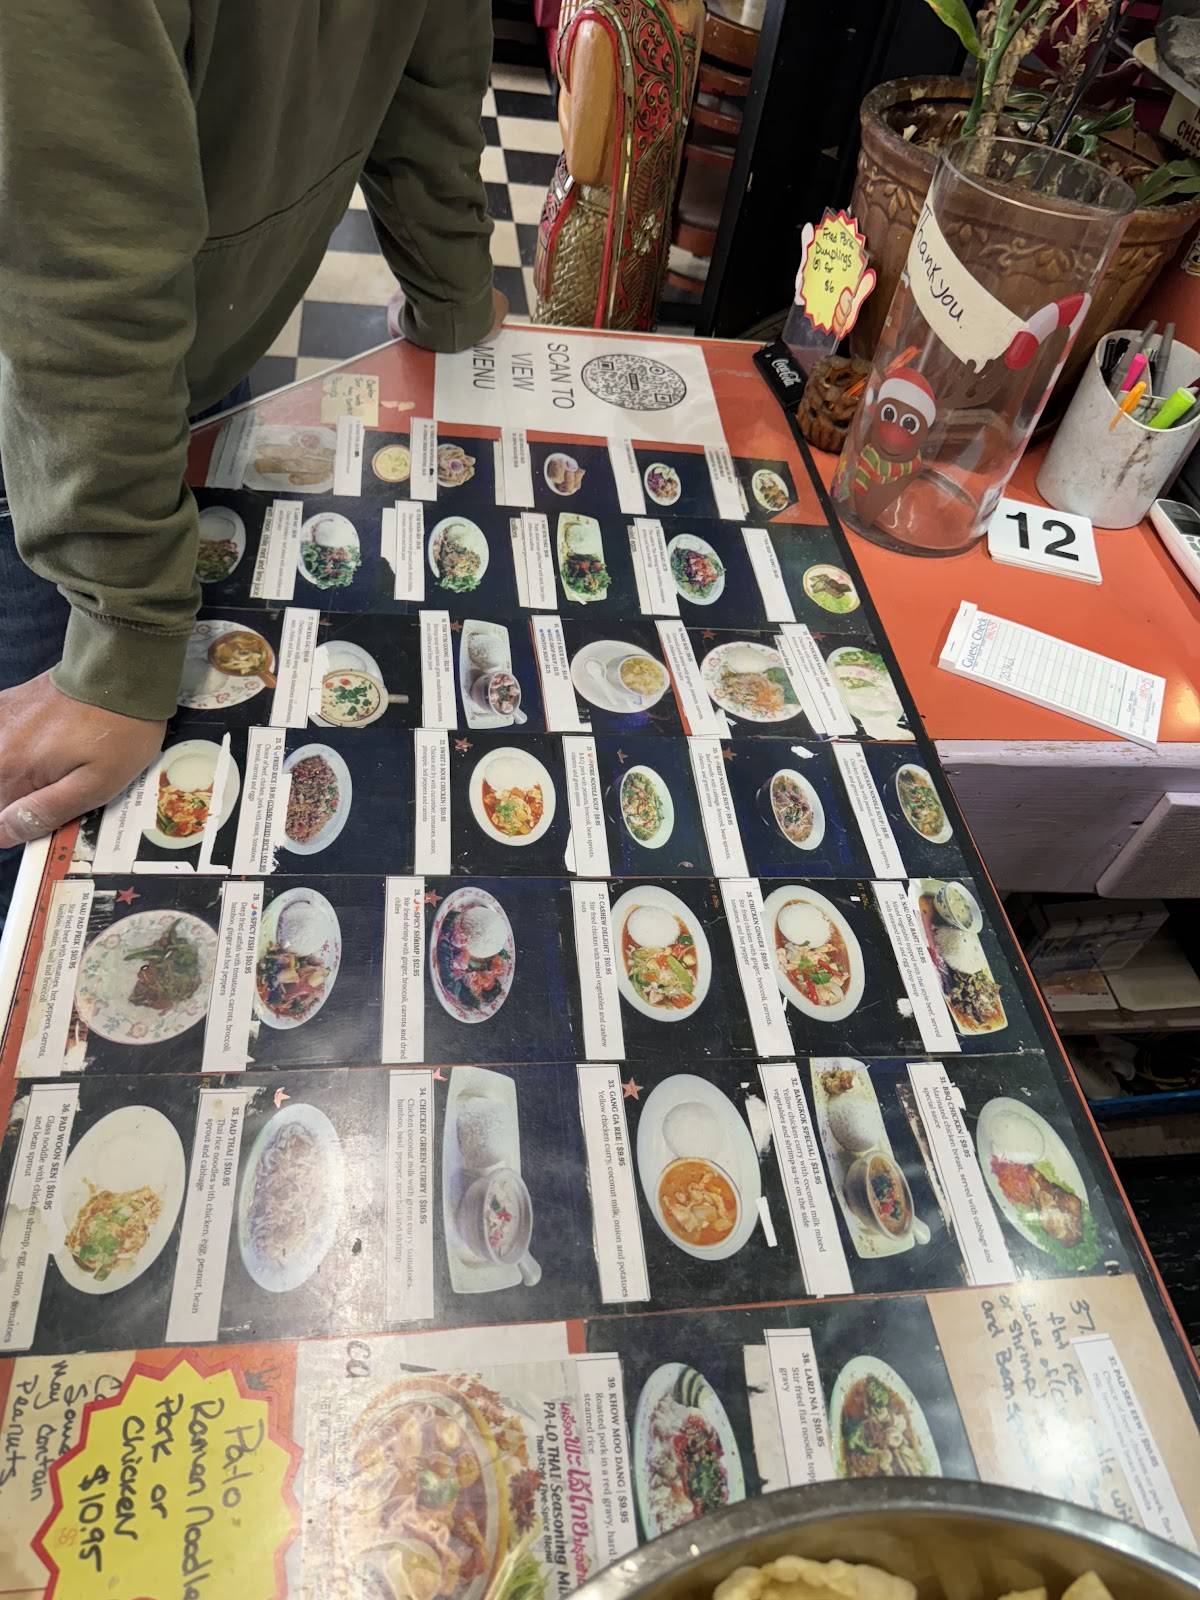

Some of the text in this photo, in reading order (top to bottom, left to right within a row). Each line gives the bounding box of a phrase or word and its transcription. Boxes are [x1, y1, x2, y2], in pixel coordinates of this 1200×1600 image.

[1177, 120, 1200, 153] CHEC
[916, 204, 941, 280] Thank
[815, 242, 852, 271] Dumplings
[472, 345, 495, 390] MENU
[511, 352, 534, 391] VIEW
[547, 342, 575, 409] SCAN TO
[1005, 511, 1079, 561] 12
[961, 617, 988, 669] Guest Check
[249, 917, 257, 934] SPICY
[599, 900, 608, 925] CASHEW
[748, 898, 760, 925] CHICKEN
[754, 924, 766, 948] GINGER
[247, 936, 255, 950] FISH
[602, 926, 610, 952] DELIGHT
[609, 1090, 619, 1112] GANG
[942, 1085, 953, 1101] BBQ
[44, 1115, 55, 1135] Glass
[58, 1115, 67, 1131] PAD
[229, 1119, 238, 1135] PAD
[612, 1113, 620, 1124] GA
[947, 1100, 963, 1134] CHICKEN
[22, 1115, 42, 1178] and bean sprout
[53, 1133, 64, 1160] WOON
[226, 1136, 236, 1156] THAI
[614, 1126, 622, 1140] REE
[794, 1087, 808, 1124] BANGKOK
[802, 1125, 815, 1156] SPECIAL
[809, 1161, 822, 1185] $13.95
[39, 1136, 51, 1163] noddle
[615, 1146, 625, 1166] $9.95
[35, 1164, 45, 1183] with
[50, 1162, 59, 1178] SEN
[221, 1161, 232, 1186] $10.95
[43, 1184, 56, 1211] $10.95
[598, 1090, 629, 1297] Yellow chicken curry, coconut milk, onion and potatoes
[192, 1119, 224, 1314] Thai rice noodles with chicken, egg, peanut, bean
[419, 1199, 427, 1224] $10.95
[20, 1217, 35, 1249] shrimp,
[17, 1250, 27, 1268] egg,
[12, 1270, 25, 1298] onion,
[4, 1299, 20, 1344] tomatoes
[1021, 1304, 1043, 1346] hoice
[1070, 1299, 1095, 1335] 37.
[981, 1300, 1016, 1400] and Bean
[780, 1367, 790, 1392] gravy
[791, 1366, 801, 1382] Stir
[804, 1367, 816, 1394] LARD
[794, 1385, 804, 1407] fried
[809, 1396, 818, 1410] NA
[544, 1401, 558, 1441] PA-LO
[584, 1393, 596, 1454] steamed rice
[595, 1392, 606, 1429] Roasted
[797, 1409, 807, 1424] flat
[596, 1432, 608, 1454] pork
[800, 1426, 812, 1459] noodle
[811, 1417, 824, 1447] $10.95
[151, 1394, 184, 1520] Pork or
[187, 1398, 225, 1496] Ramen
[608, 1376, 629, 1523] 39. KHOW MOO DANG $9.95
[547, 1447, 561, 1478] THAI
[600, 1457, 609, 1466] in
[602, 1477, 612, 1495] red
[78, 1464, 110, 1572] $10.95
[547, 1484, 568, 1565] Seasoning
[601, 1497, 612, 1528] gravy,
[606, 1530, 616, 1556] hard
